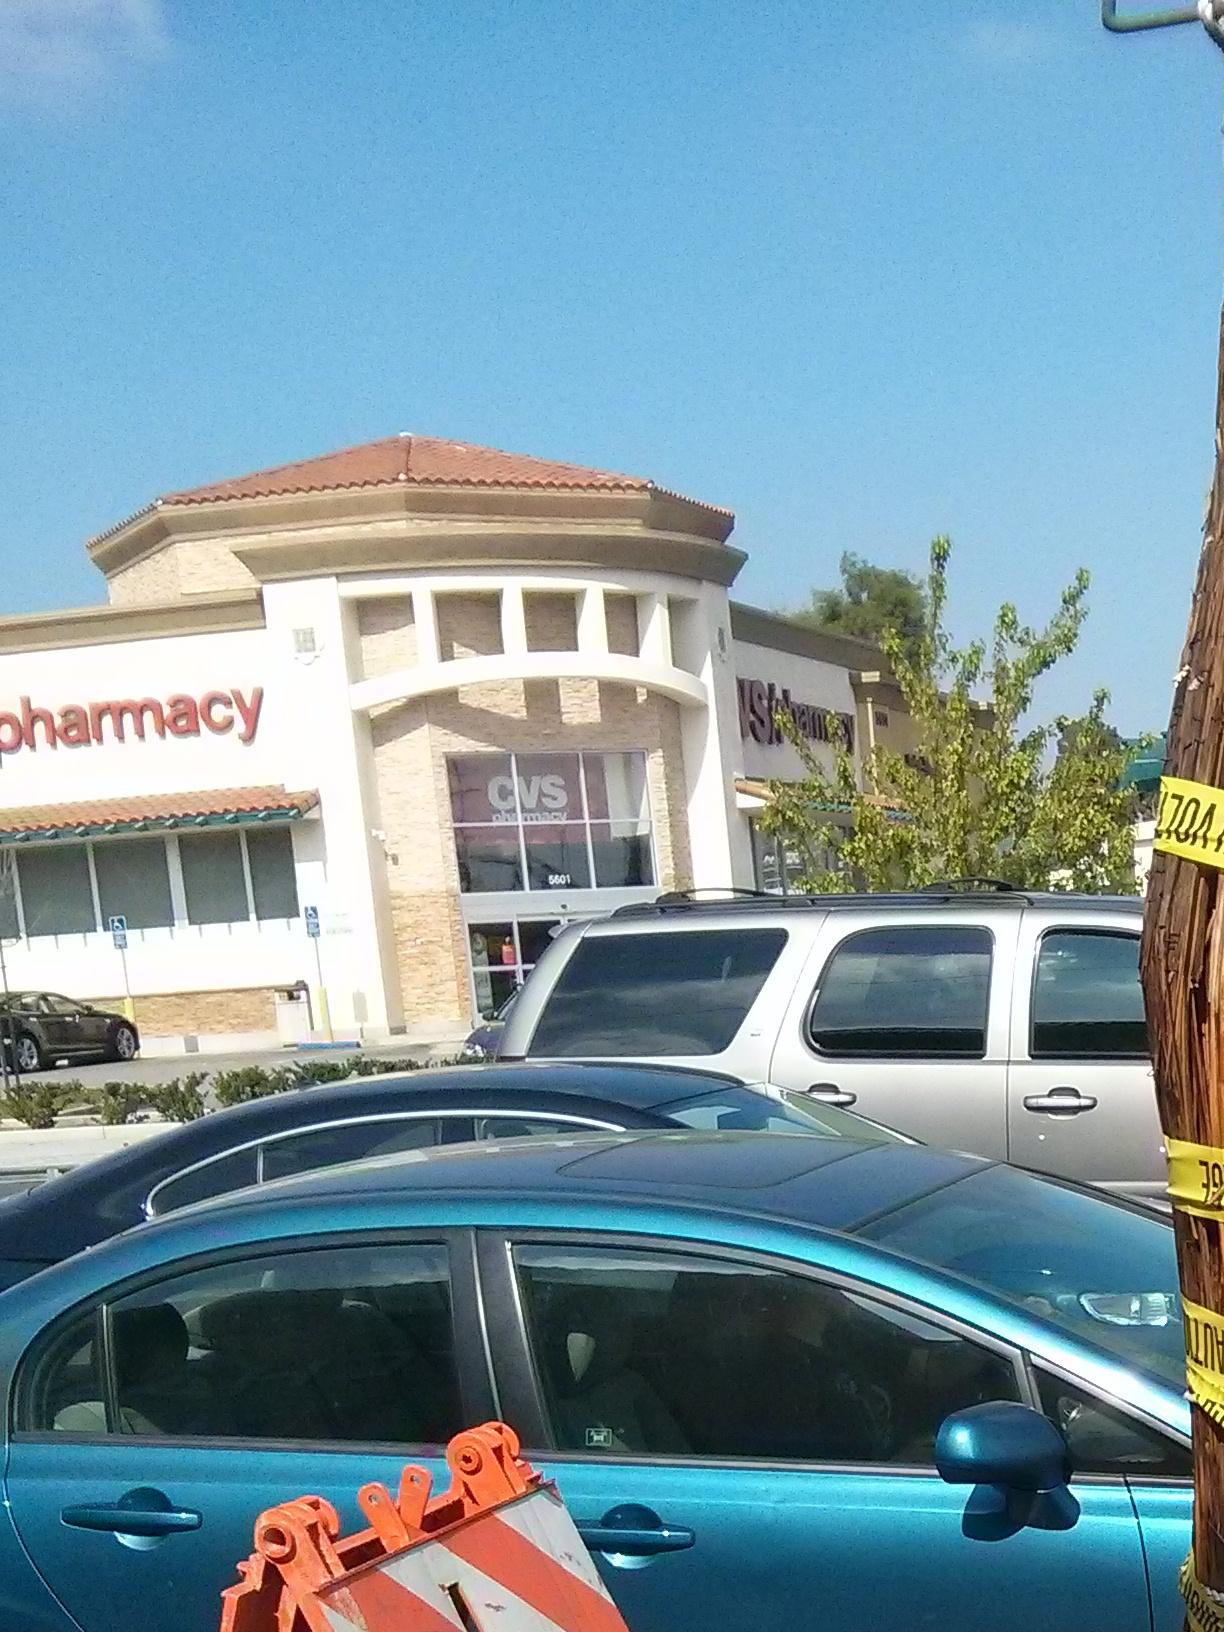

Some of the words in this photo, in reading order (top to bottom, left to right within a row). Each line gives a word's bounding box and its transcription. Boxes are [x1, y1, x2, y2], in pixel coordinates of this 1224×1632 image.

[0, 686, 264, 769] pharmacy
[487, 774, 569, 811] CVS
[492, 811, 568, 823] phamacy
